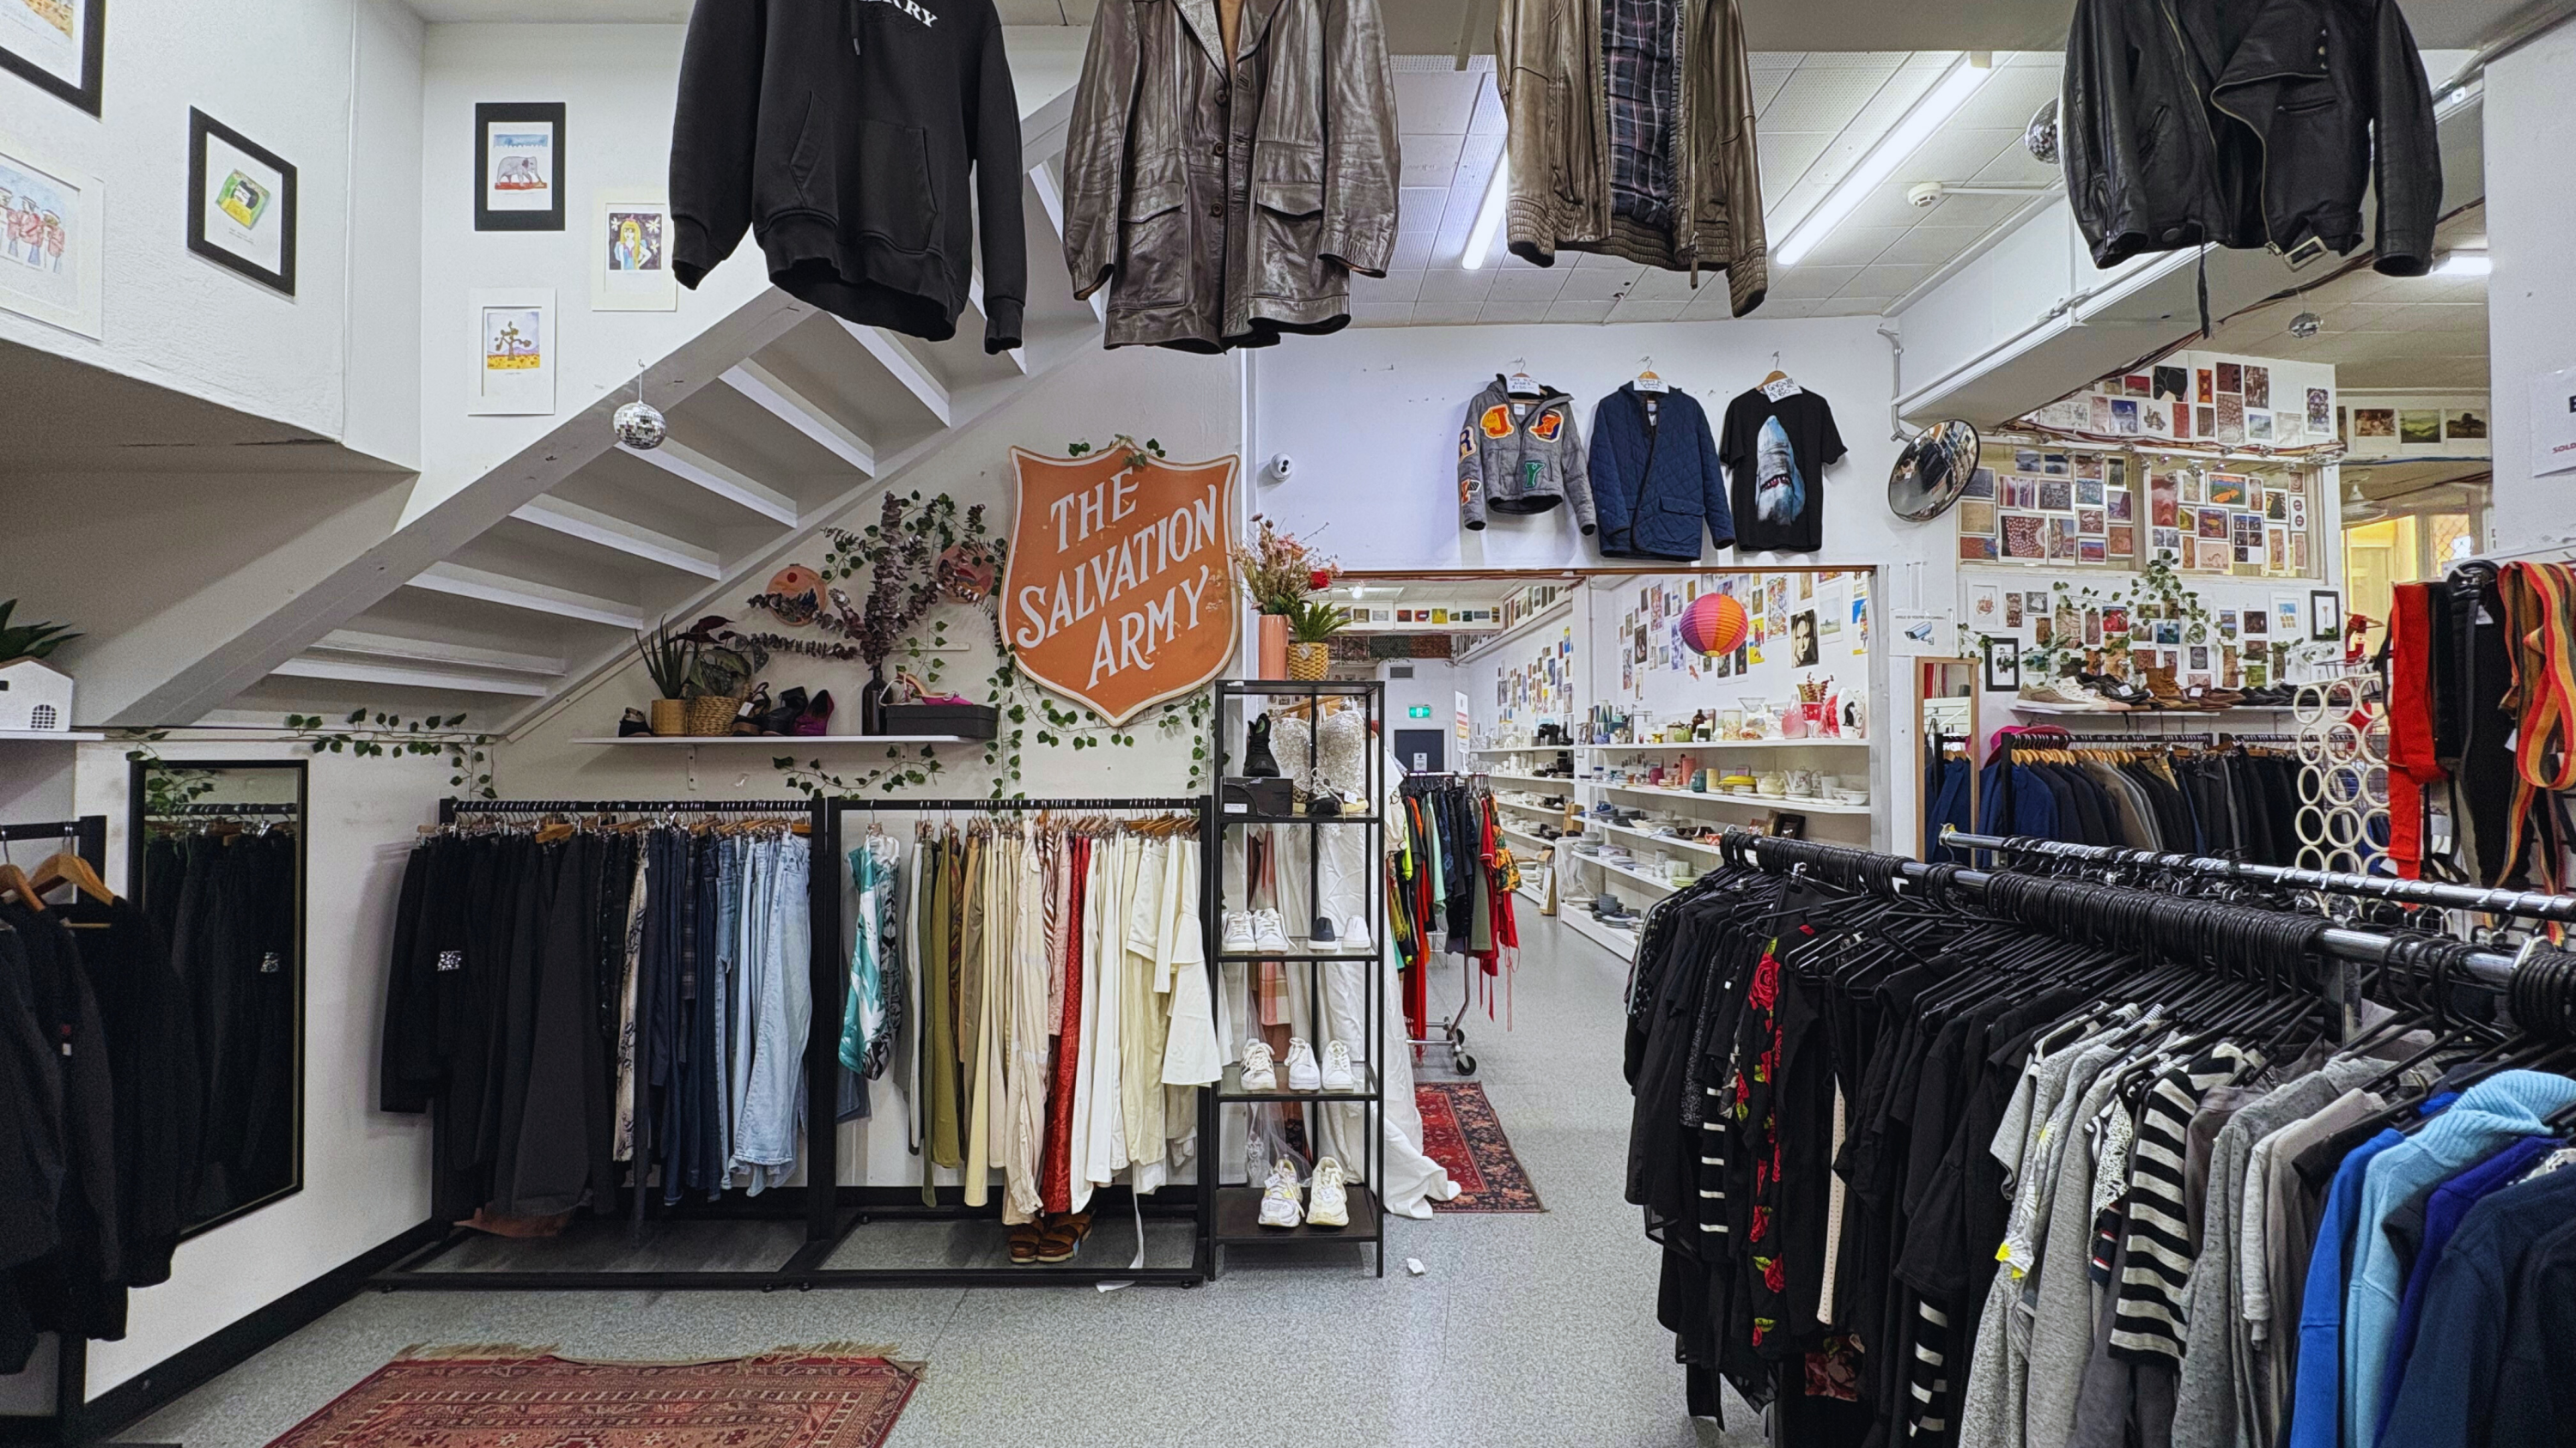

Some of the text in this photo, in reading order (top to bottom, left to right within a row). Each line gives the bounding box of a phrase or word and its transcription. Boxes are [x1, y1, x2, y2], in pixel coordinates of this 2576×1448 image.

[1017, 484, 1217, 648] SALVATION
[1050, 466, 1139, 554] THE
[1085, 565, 1209, 691] ARMY
